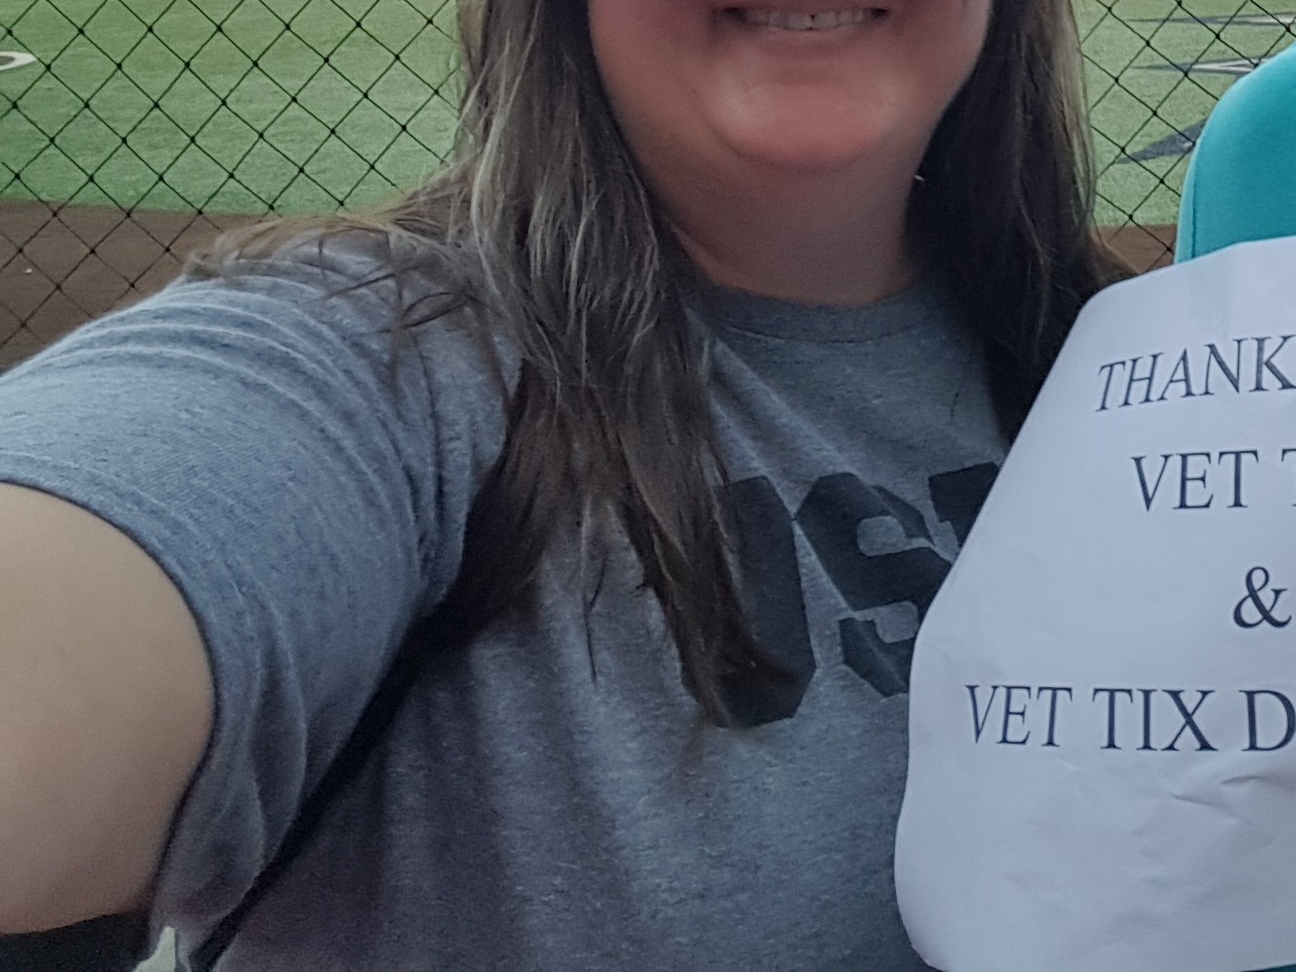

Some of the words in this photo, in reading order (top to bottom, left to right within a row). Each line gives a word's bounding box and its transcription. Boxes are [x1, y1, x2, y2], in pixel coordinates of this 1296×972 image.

[1130, 449, 1260, 512] VET
[1232, 566, 1293, 630] &
[964, 684, 1073, 748] VET
[1091, 687, 1219, 752] TIX
